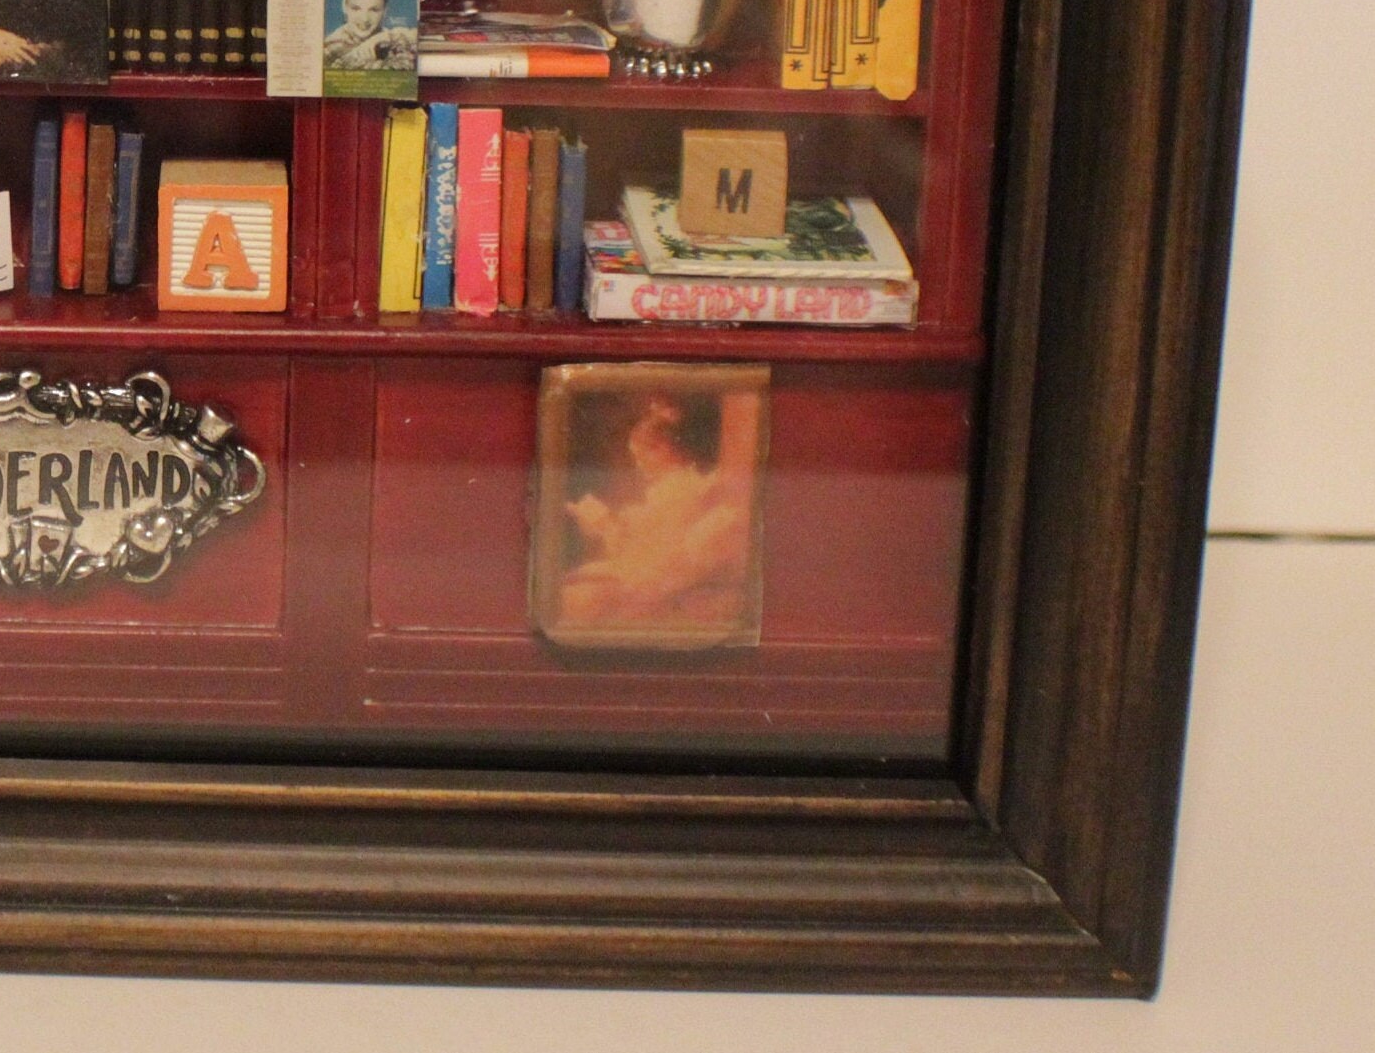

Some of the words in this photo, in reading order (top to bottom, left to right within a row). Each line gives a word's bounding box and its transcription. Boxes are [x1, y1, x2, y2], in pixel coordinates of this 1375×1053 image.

[715, 167, 753, 214] M
[181, 210, 261, 290] A
[631, 283, 768, 320] CANDY
[774, 285, 873, 320] LAND
